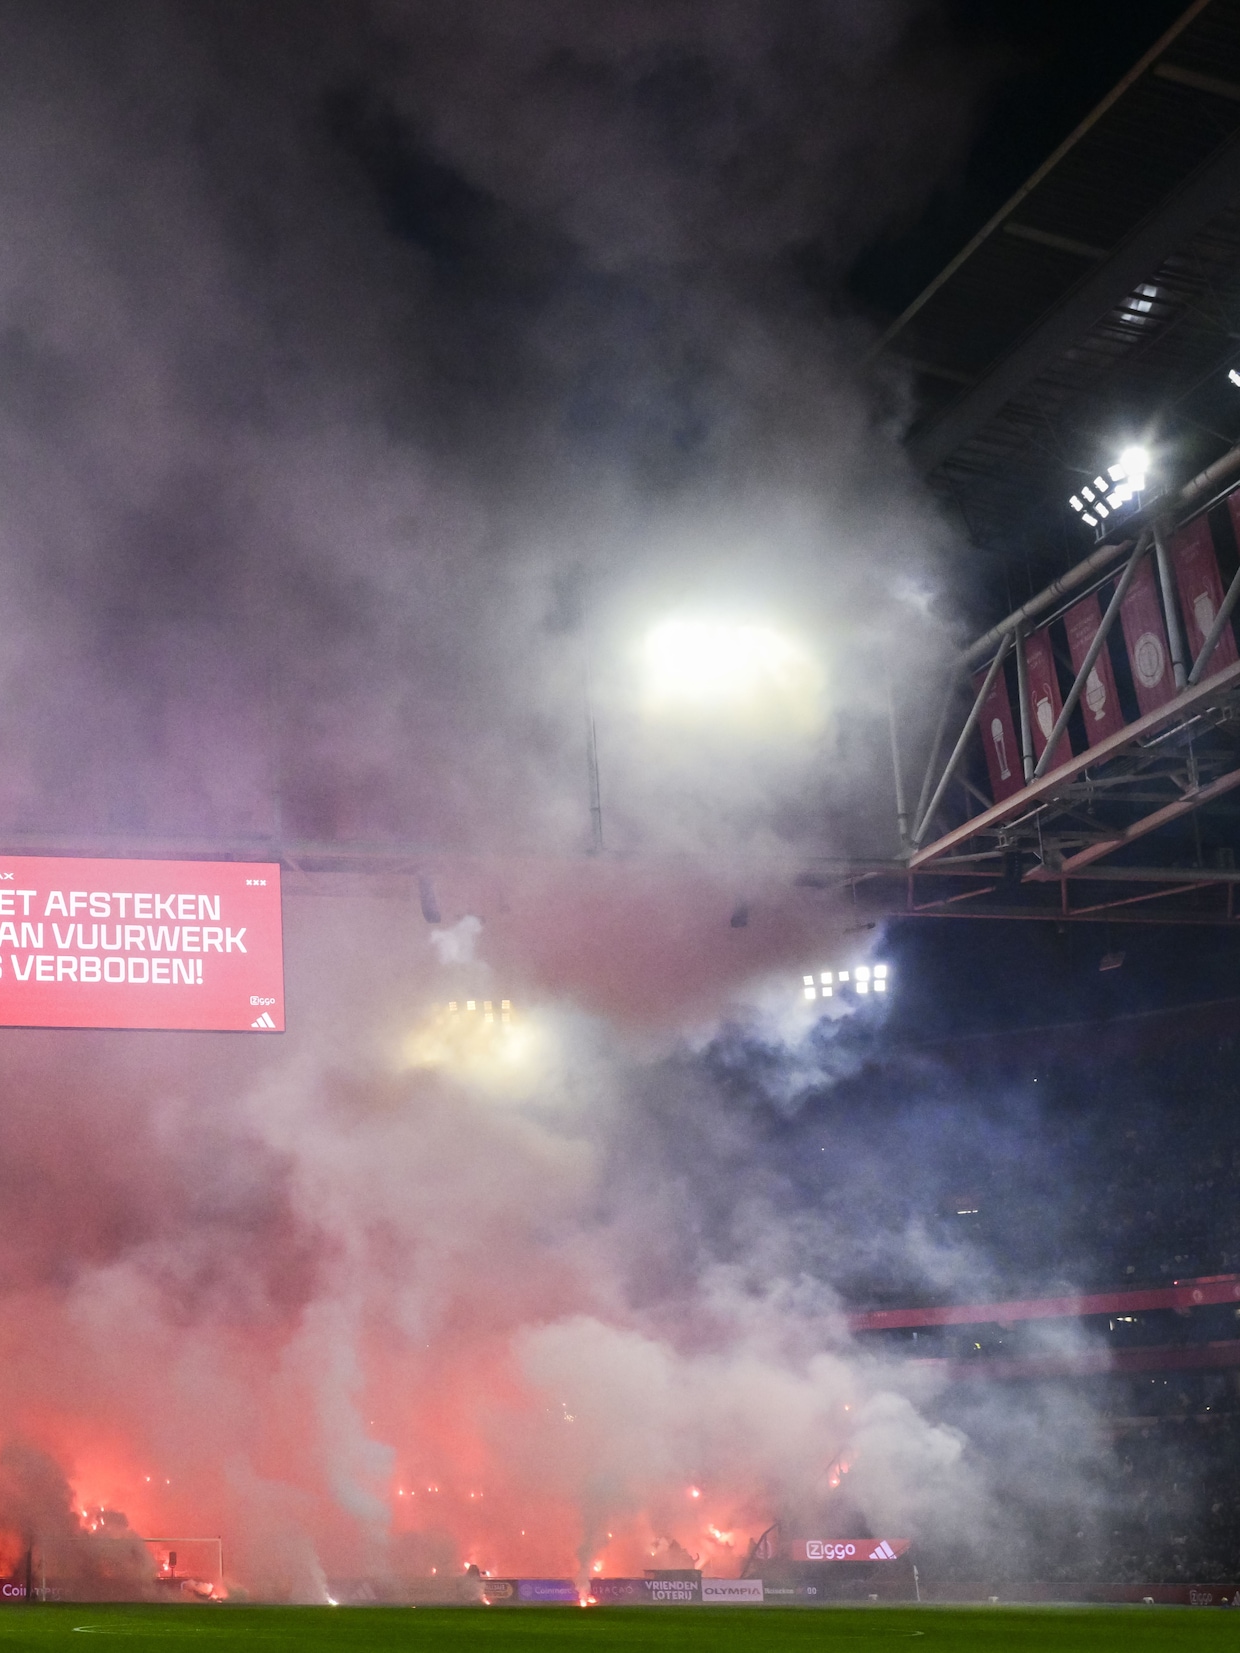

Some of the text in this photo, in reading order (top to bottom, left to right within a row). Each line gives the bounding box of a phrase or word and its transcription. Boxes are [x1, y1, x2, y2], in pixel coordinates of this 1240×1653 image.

[44, 890, 220, 921] AFSTEKEN
[52, 922, 247, 953] VUURWERK
[10, 954, 203, 985] VERBODEN!
[645, 1580, 699, 1591] VRIENDEN
[652, 1590, 693, 1601] LOTERIJ
[704, 1587, 761, 1595] OLYMPIA
